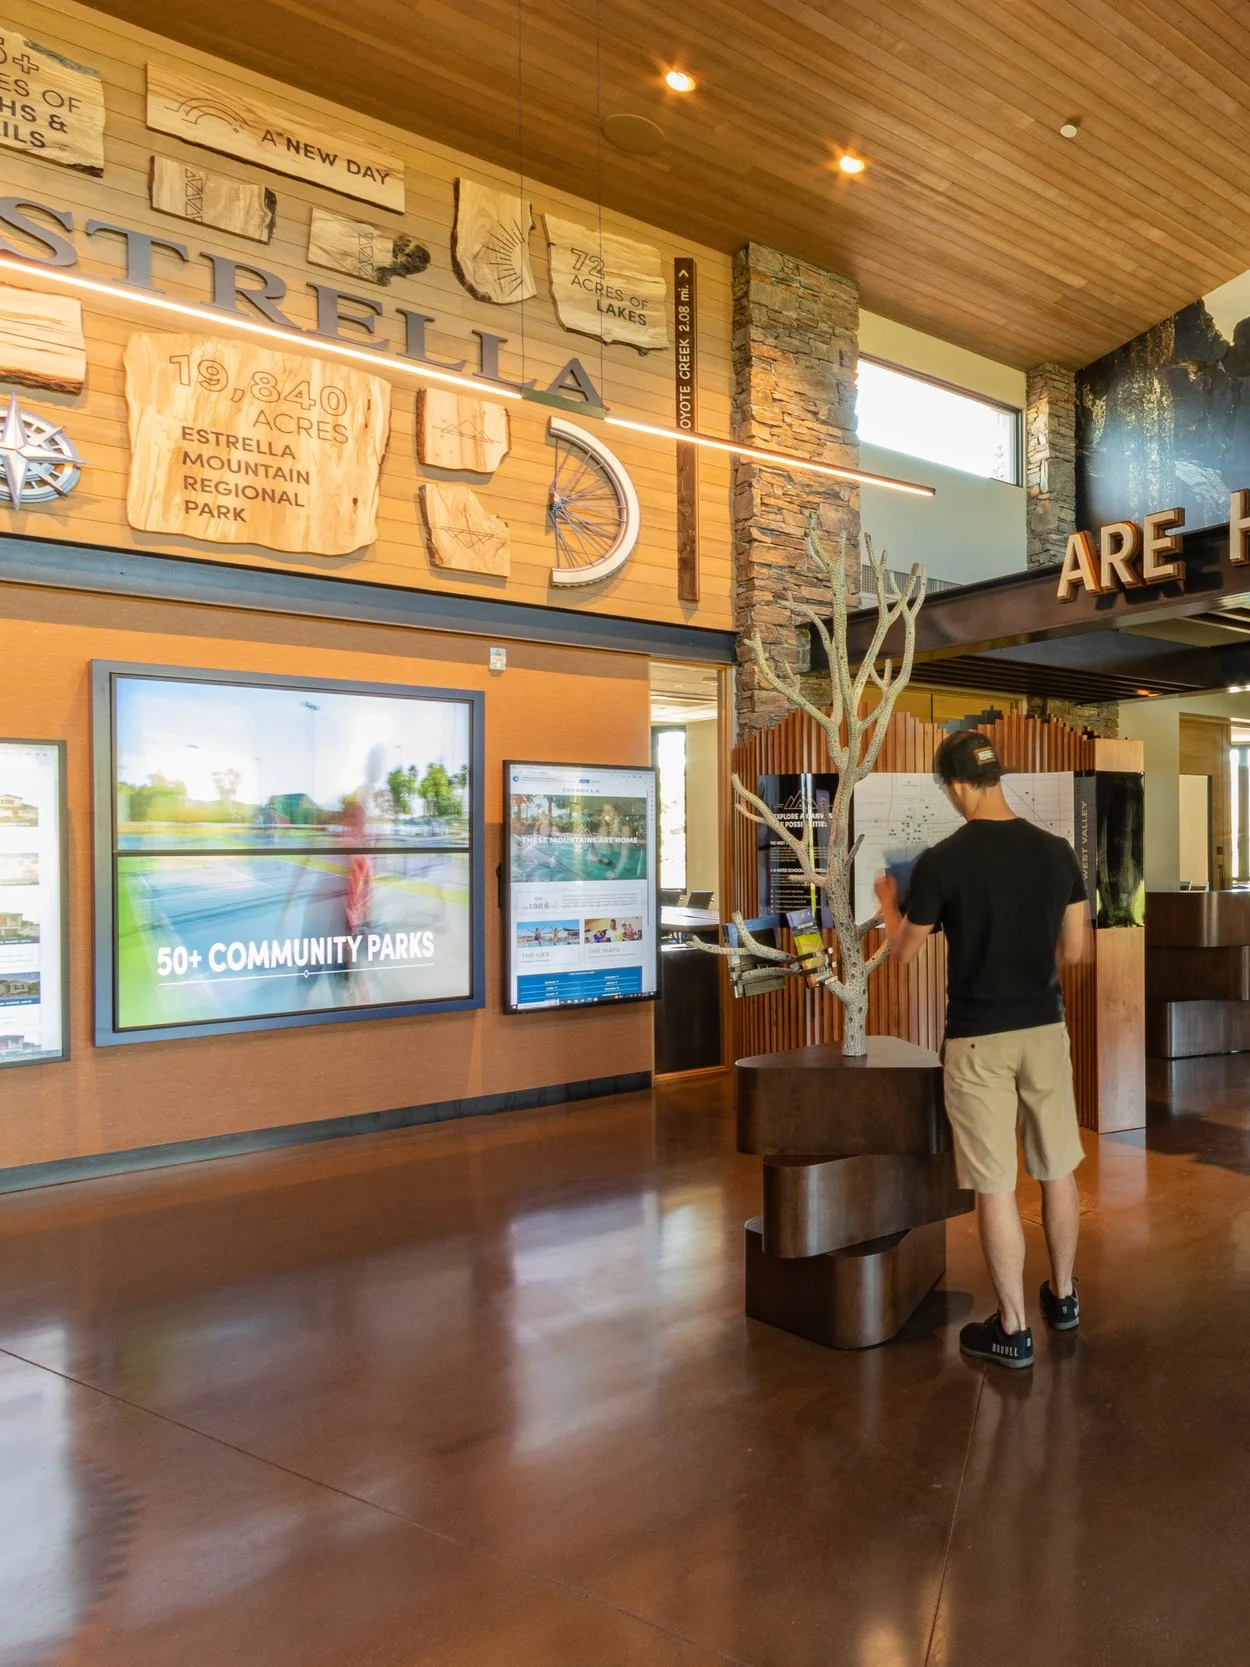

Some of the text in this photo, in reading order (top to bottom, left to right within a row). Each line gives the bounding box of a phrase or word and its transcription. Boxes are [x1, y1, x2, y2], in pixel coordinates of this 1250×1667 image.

[42, 89, 82, 114] OF
[48, 113, 68, 134] &
[261, 129, 390, 186] A NEW DAY
[571, 247, 605, 280] 72
[0, 196, 608, 411] STRELLA
[571, 275, 650, 311] ACRES OF
[596, 299, 648, 327] LAKES
[678, 284, 692, 432] OYOTE CREEK 2.08 mi.
[169, 354, 348, 417] 19,840
[181, 426, 296, 461] ESTRELLA
[252, 409, 349, 445] ACRES
[181, 452, 311, 486] MOUNTAIN
[183, 475, 306, 508] REGIONAL
[184, 499, 247, 524] PARK
[1057, 507, 1186, 601] ARE
[156, 930, 435, 977] 50+ COMMUNITY PARKS
